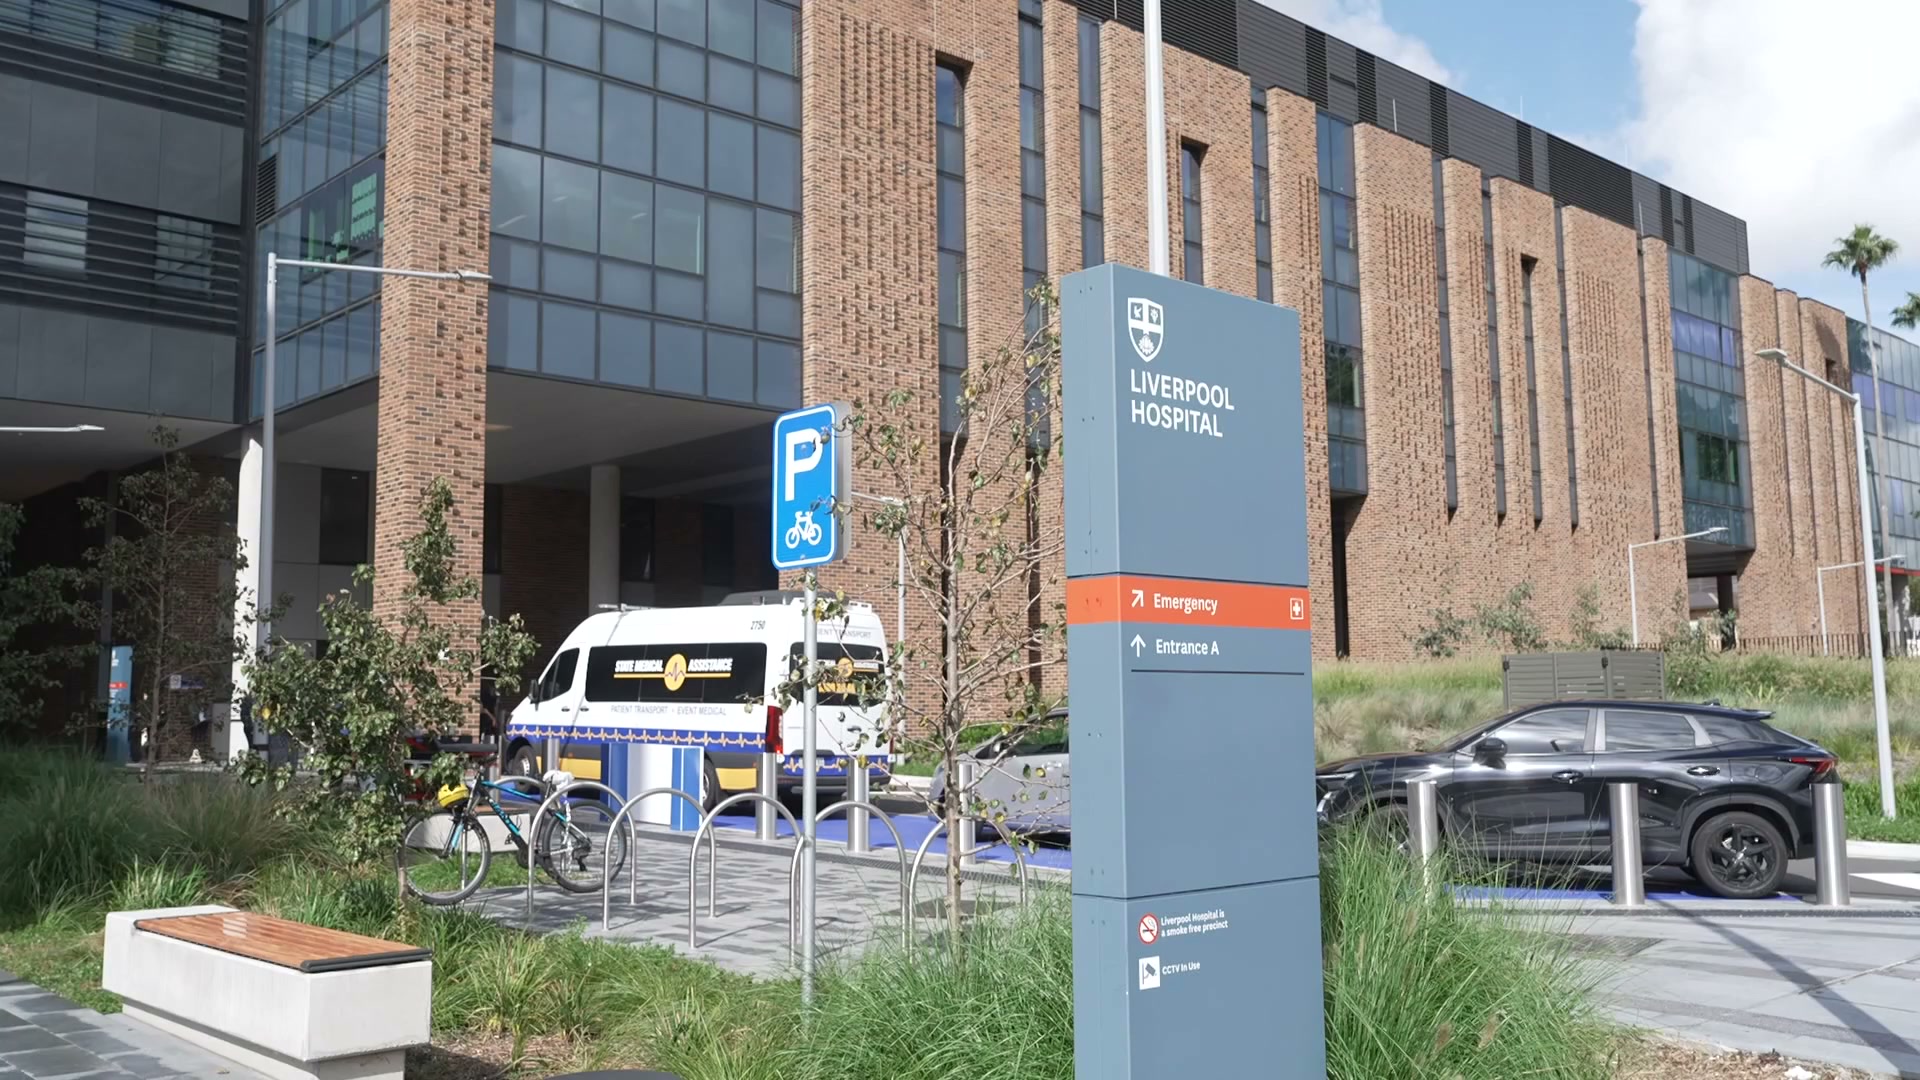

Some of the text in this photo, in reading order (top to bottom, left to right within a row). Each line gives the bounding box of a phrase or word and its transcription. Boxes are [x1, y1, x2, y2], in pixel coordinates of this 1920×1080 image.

[1131, 369, 1235, 410] LIVERPOOL
[1131, 400, 1223, 438] HOSPITAL
[785, 428, 823, 501] P
[1154, 593, 1218, 615] Emergency
[750, 620, 766, 630] 2750
[1156, 639, 1219, 655] Entrance A
[615, 658, 733, 672] STATE MEDICAL ASSISTANCE
[610, 704, 727, 716] PATIENT TRANSPORT EVENT MEDICAL
[1161, 909, 1225, 926] Liverpool Hospital is
[1167, 925, 1187, 936] smoke
[1188, 924, 1201, 933] free
[1202, 920, 1228, 933] precinct
[1162, 964, 1180, 975] CCTV
[1188, 962, 1200, 970] Use
